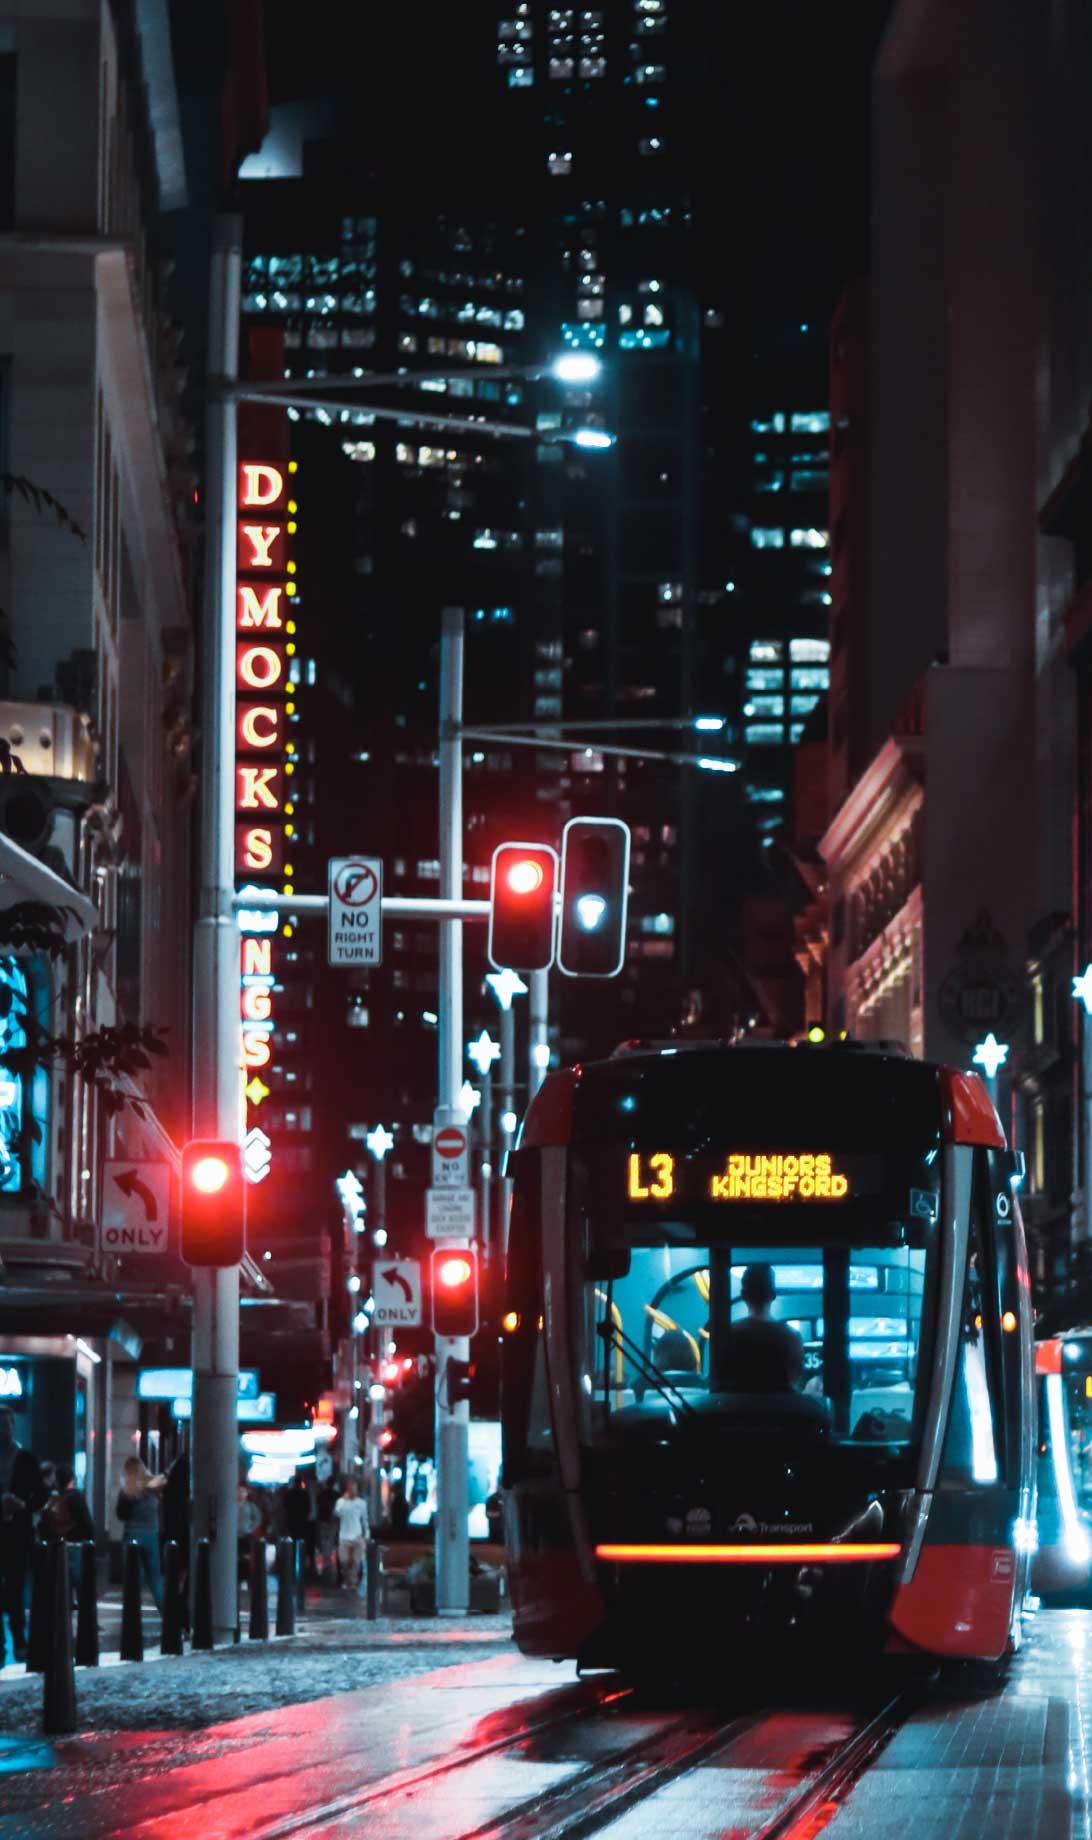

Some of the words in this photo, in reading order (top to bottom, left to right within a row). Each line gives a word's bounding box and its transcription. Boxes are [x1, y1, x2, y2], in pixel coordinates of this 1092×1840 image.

[238, 463, 284, 870] DYMOCKS
[341, 911, 369, 928] NO
[335, 932, 375, 943] RIGHT
[337, 947, 374, 959] TURN
[441, 1162, 460, 1172] NO
[728, 1155, 832, 1177] JUNIORS
[630, 1153, 674, 1198] L3
[712, 1176, 849, 1198] KINGSFORD
[106, 1227, 163, 1246] ONLY
[377, 1307, 416, 1321] ONLY
[759, 1520, 814, 1535] Transport
